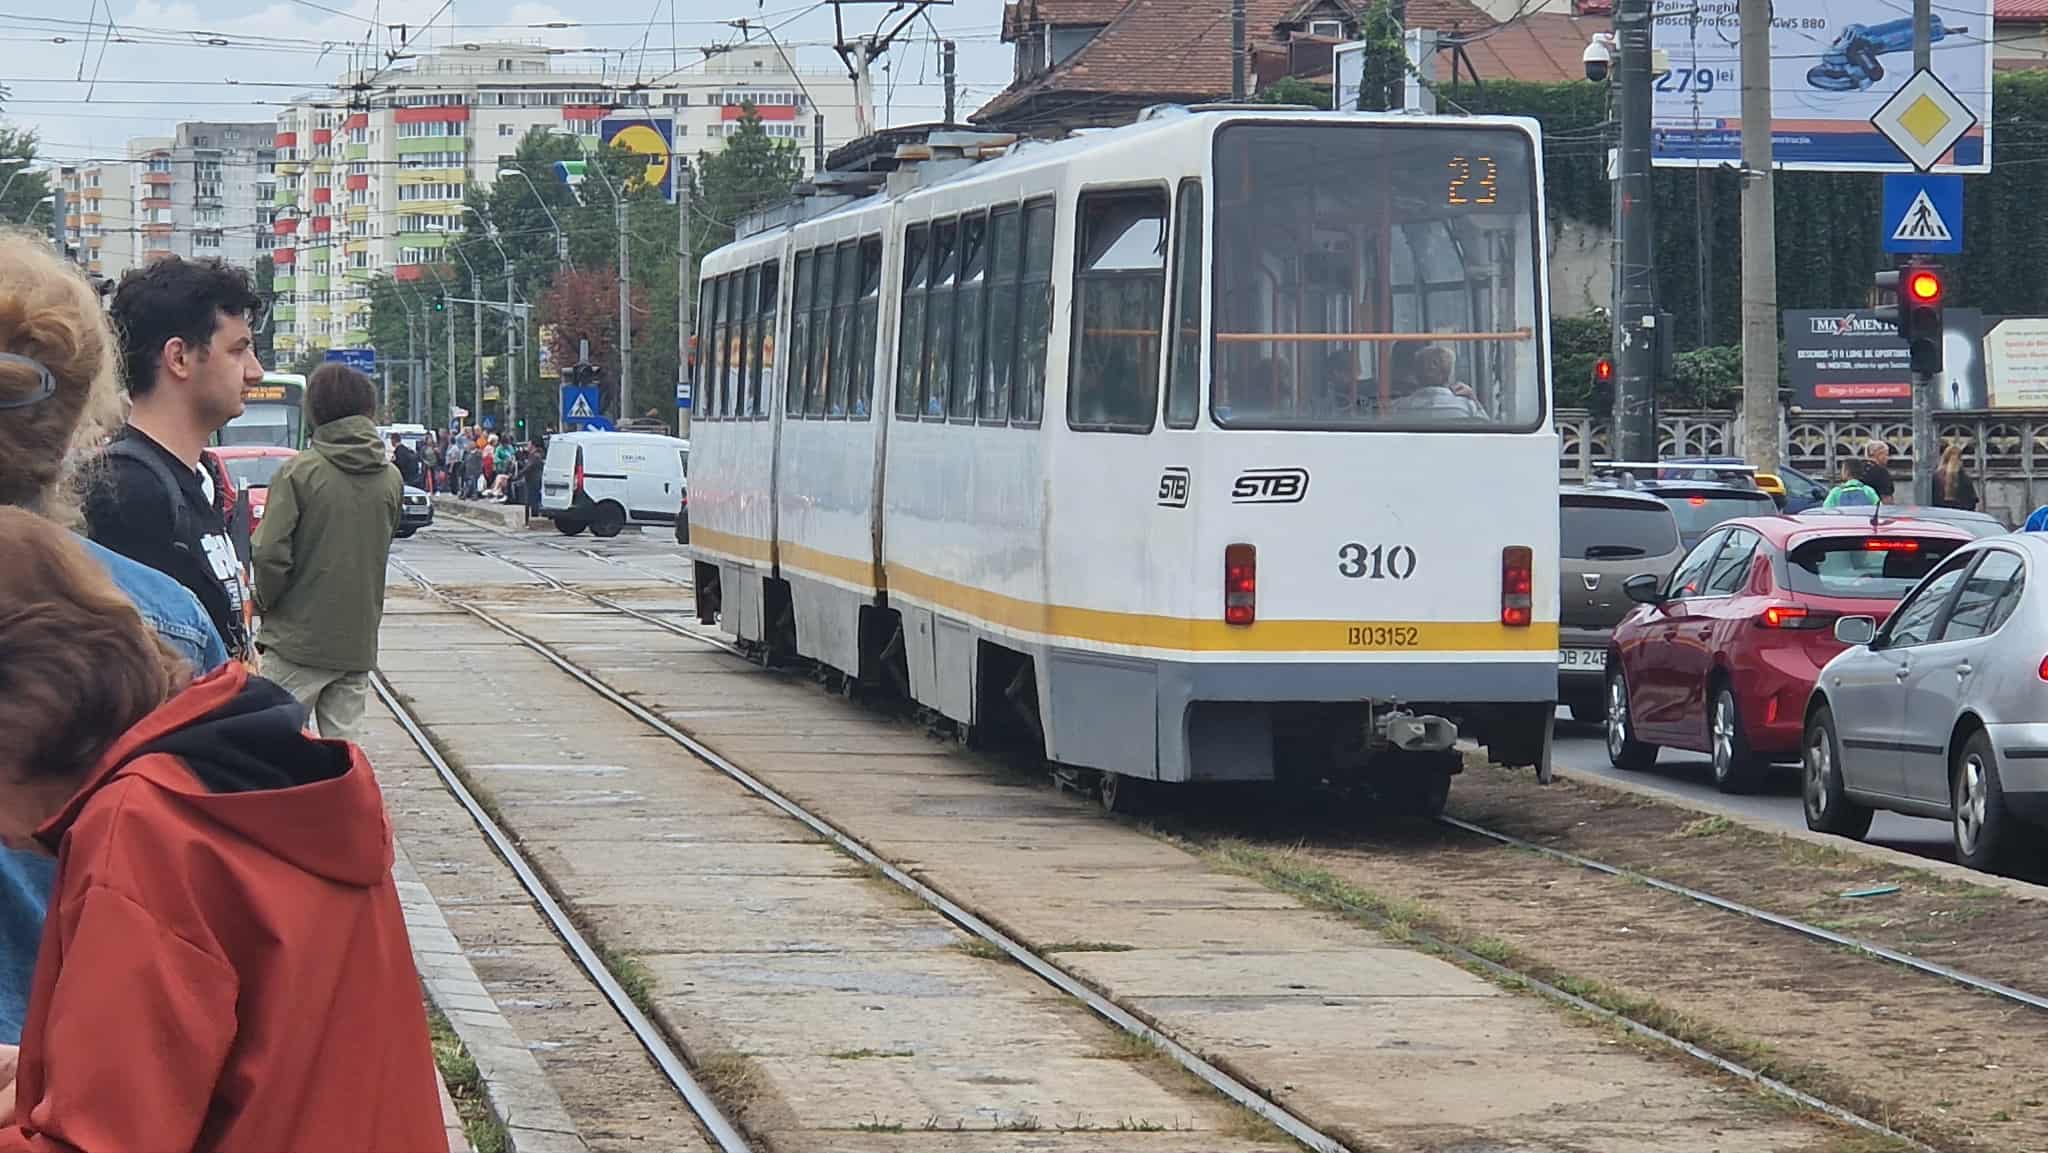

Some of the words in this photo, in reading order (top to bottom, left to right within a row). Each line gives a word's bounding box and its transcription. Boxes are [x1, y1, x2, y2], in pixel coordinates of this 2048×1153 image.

[1700, 2, 1738, 15] unghi
[1696, 15, 1740, 27] Profess
[1773, 17, 1798, 30] GWS
[1802, 18, 1826, 30] 880
[1656, 68, 1714, 93] 279
[1716, 69, 1734, 82] lei
[1448, 156, 1497, 204] 23
[1158, 474, 1188, 500] STB
[1231, 474, 1303, 498] STB
[1338, 543, 1417, 579] 310
